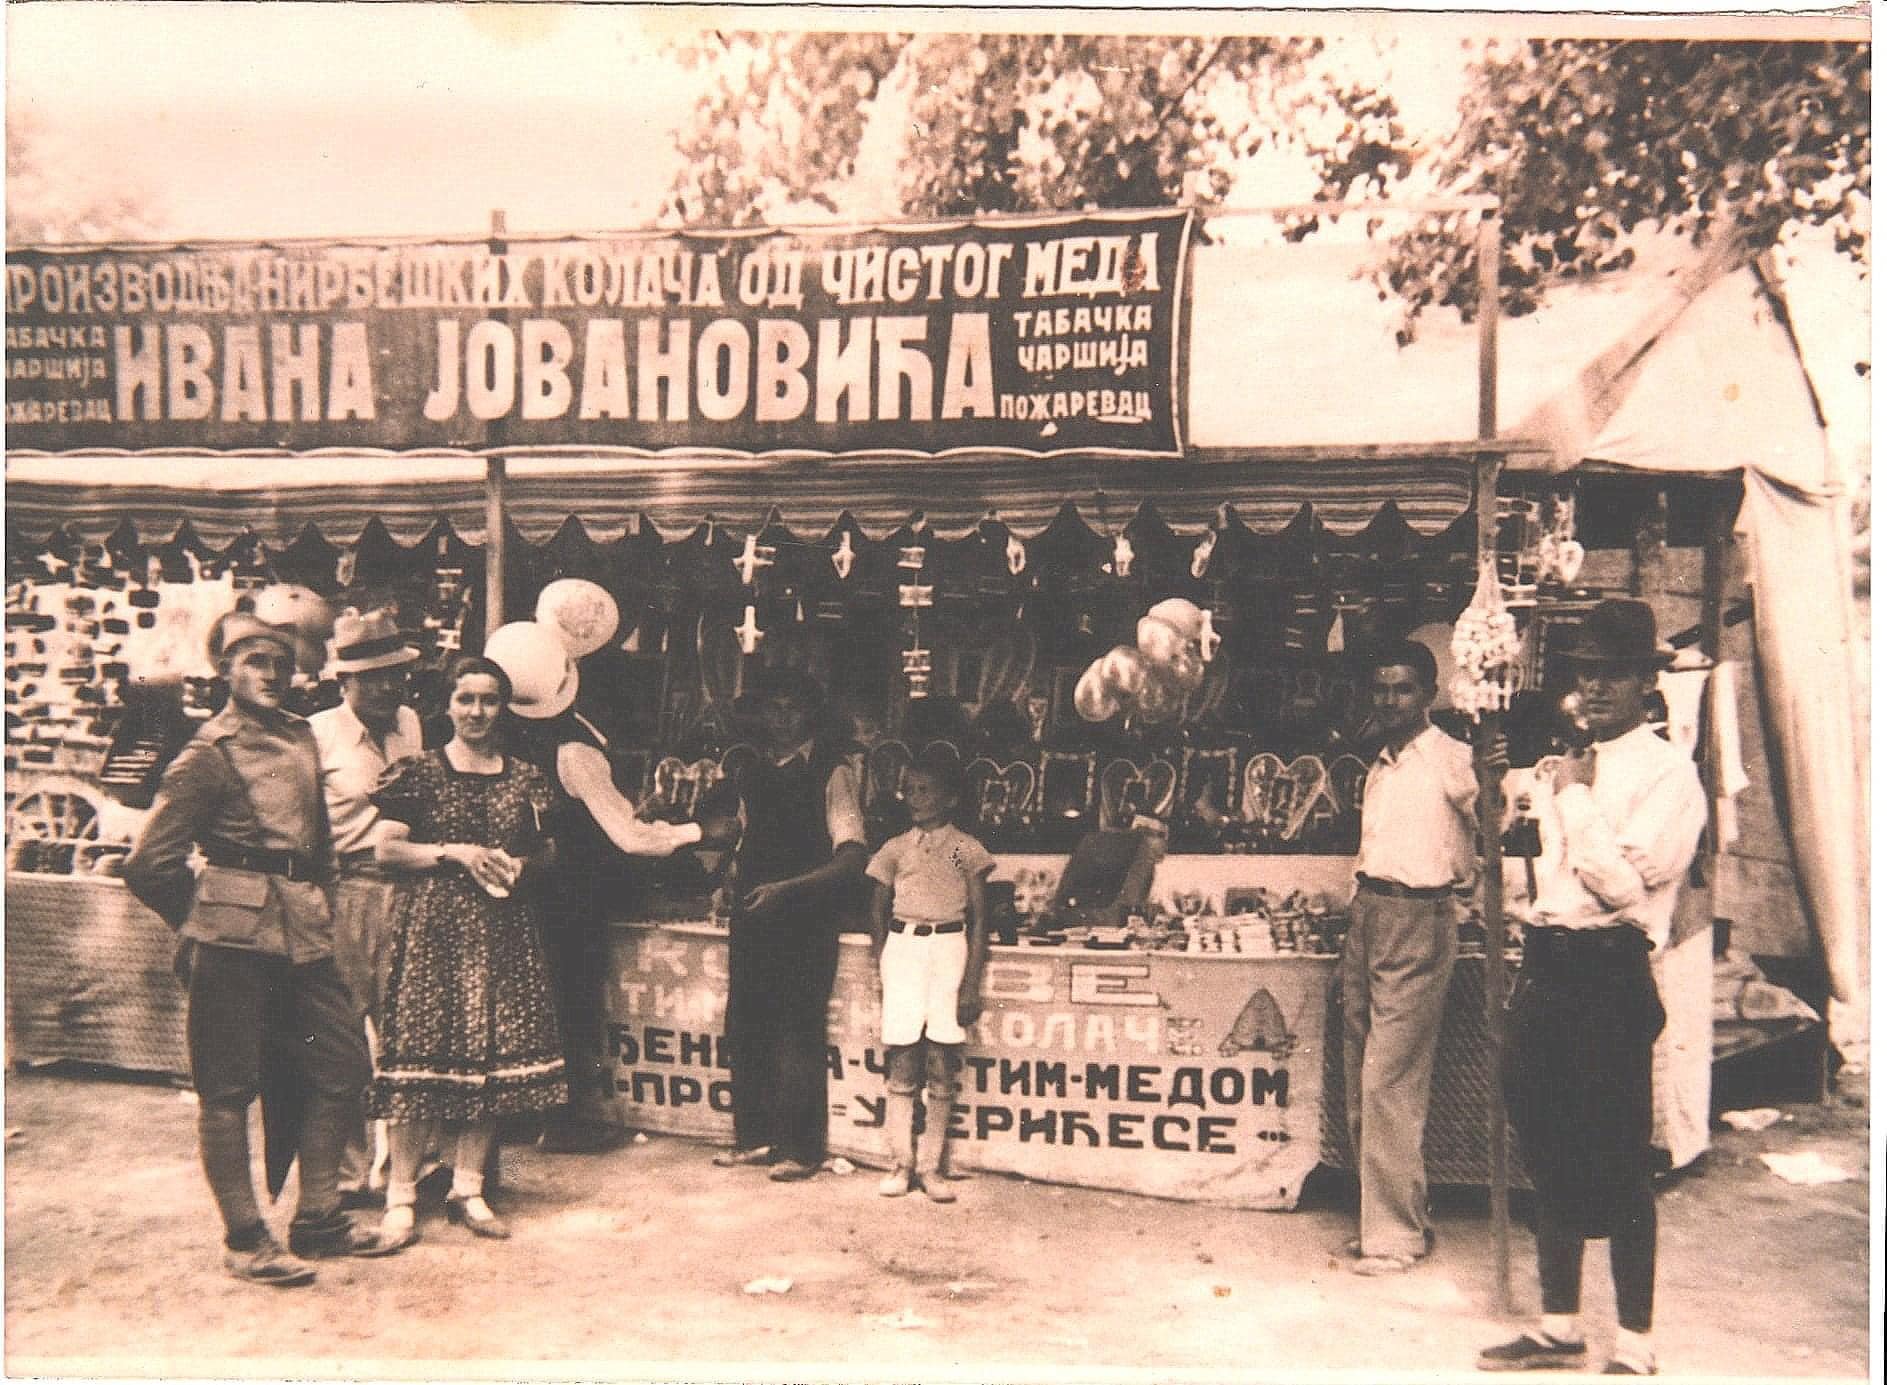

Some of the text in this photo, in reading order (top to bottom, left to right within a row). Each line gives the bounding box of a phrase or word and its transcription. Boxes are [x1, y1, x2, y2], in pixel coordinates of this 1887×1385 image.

[544, 248, 725, 307] КОЛАЧА
[739, 247, 804, 310] ОД
[821, 242, 1014, 305] ЧИСТОГ
[1022, 232, 1161, 299] МЕДА
[1013, 304, 1153, 338] ТАБАЧКА
[6, 353, 107, 389] АРШИЈА
[114, 311, 996, 423] ИВАНА ЈОВАНОВИЋА
[1017, 333, 1149, 377] ЧАРШИЈА
[1000, 389, 1153, 422] ПОЖАРЕВАЦ
